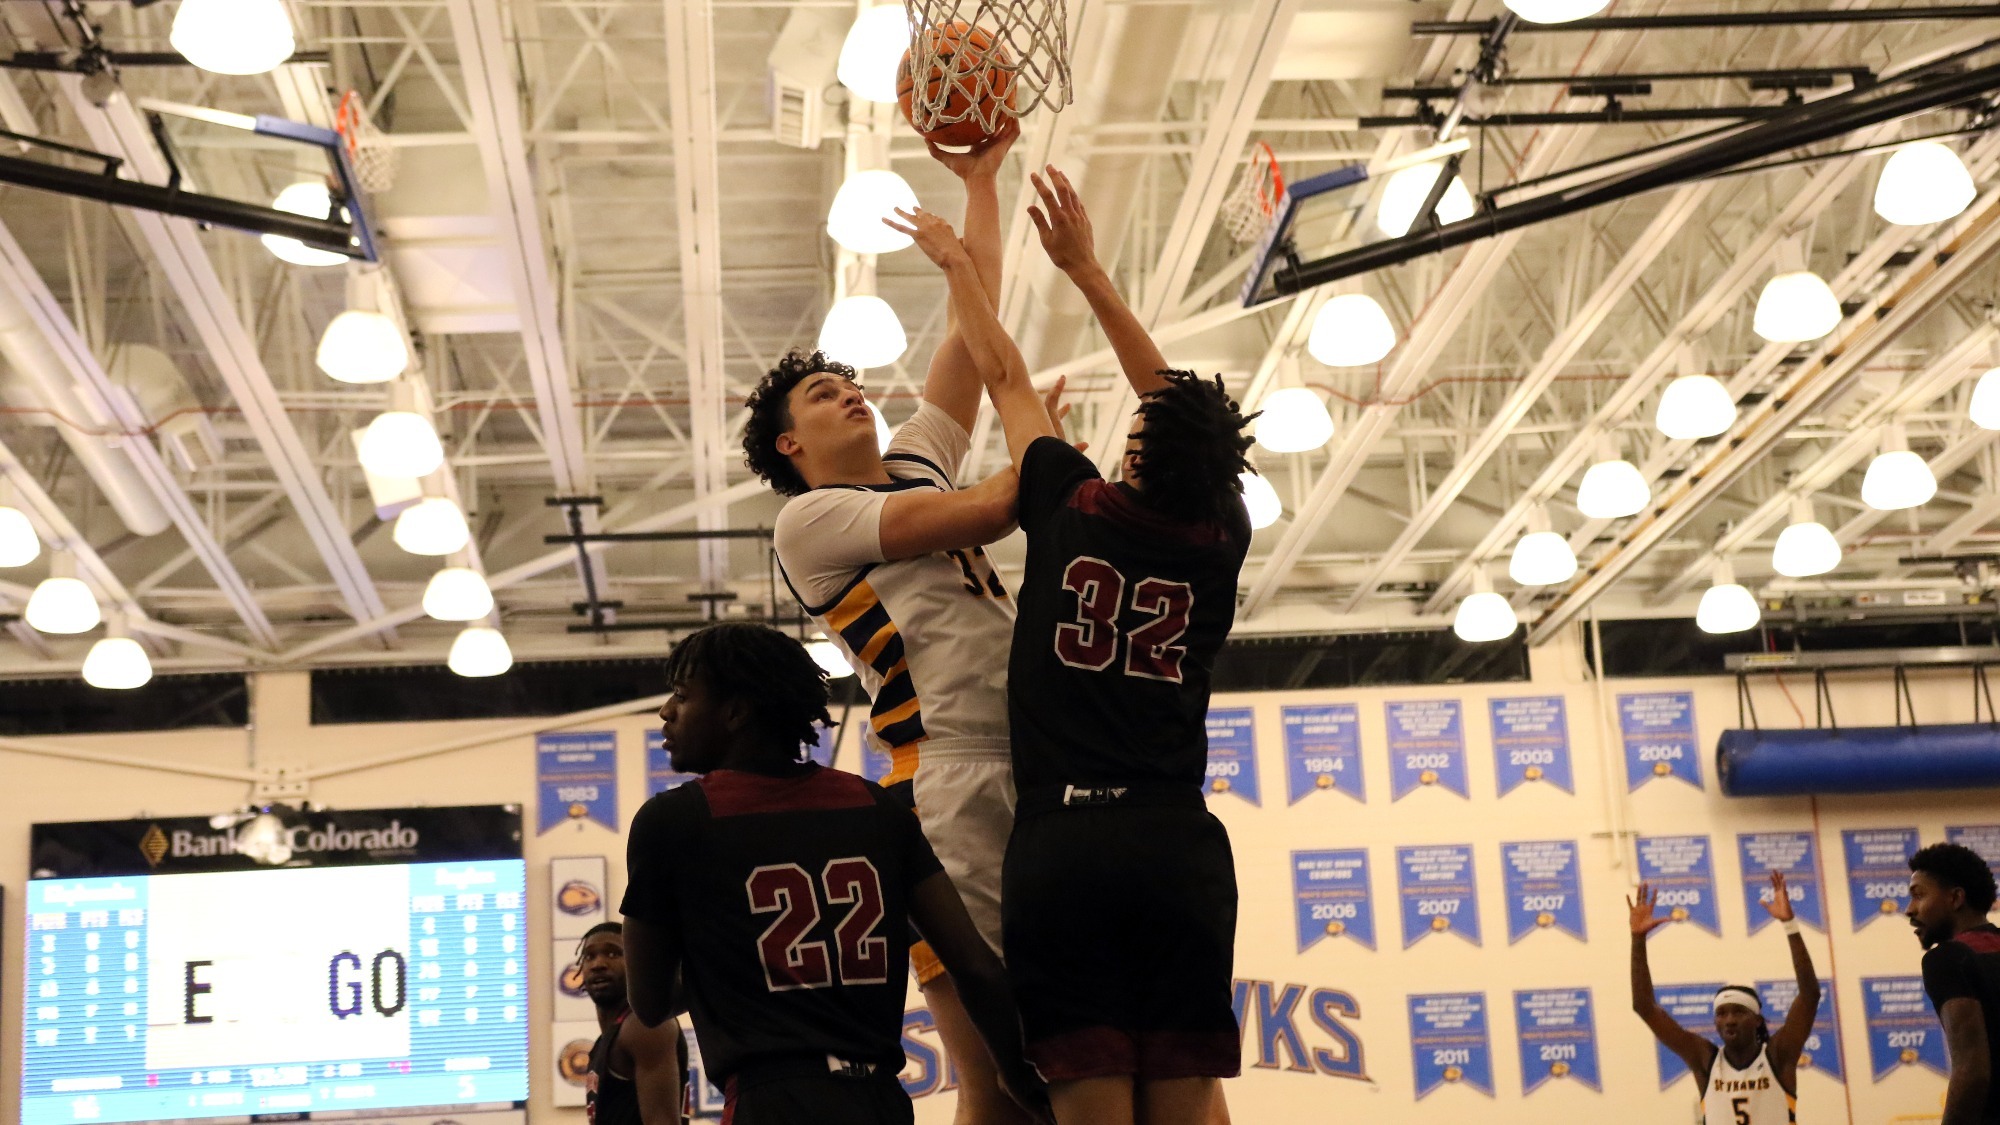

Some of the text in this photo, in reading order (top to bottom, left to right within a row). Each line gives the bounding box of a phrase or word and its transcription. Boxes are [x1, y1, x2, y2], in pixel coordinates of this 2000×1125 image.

[1055, 556, 1194, 684] 32
[1406, 753, 1449, 769] 2002
[1510, 749, 1554, 765] 2003
[1639, 745, 1683, 761] 2004
[1204, 761, 1240, 776] 990
[1304, 757, 1344, 773] 1994
[289, 819, 419, 852] Colorado
[1865, 882, 1909, 898] 2009
[1418, 898, 1461, 915] 2007
[1522, 895, 1565, 911] 2007
[745, 856, 887, 992] 22
[185, 960, 213, 1024] E
[328, 949, 406, 1020] GO
[1887, 1030, 1926, 1048] 2017
[1433, 1049, 1470, 1065] 2011
[1540, 1044, 1576, 1061] 2011
[1732, 1097, 1750, 1125] 5
